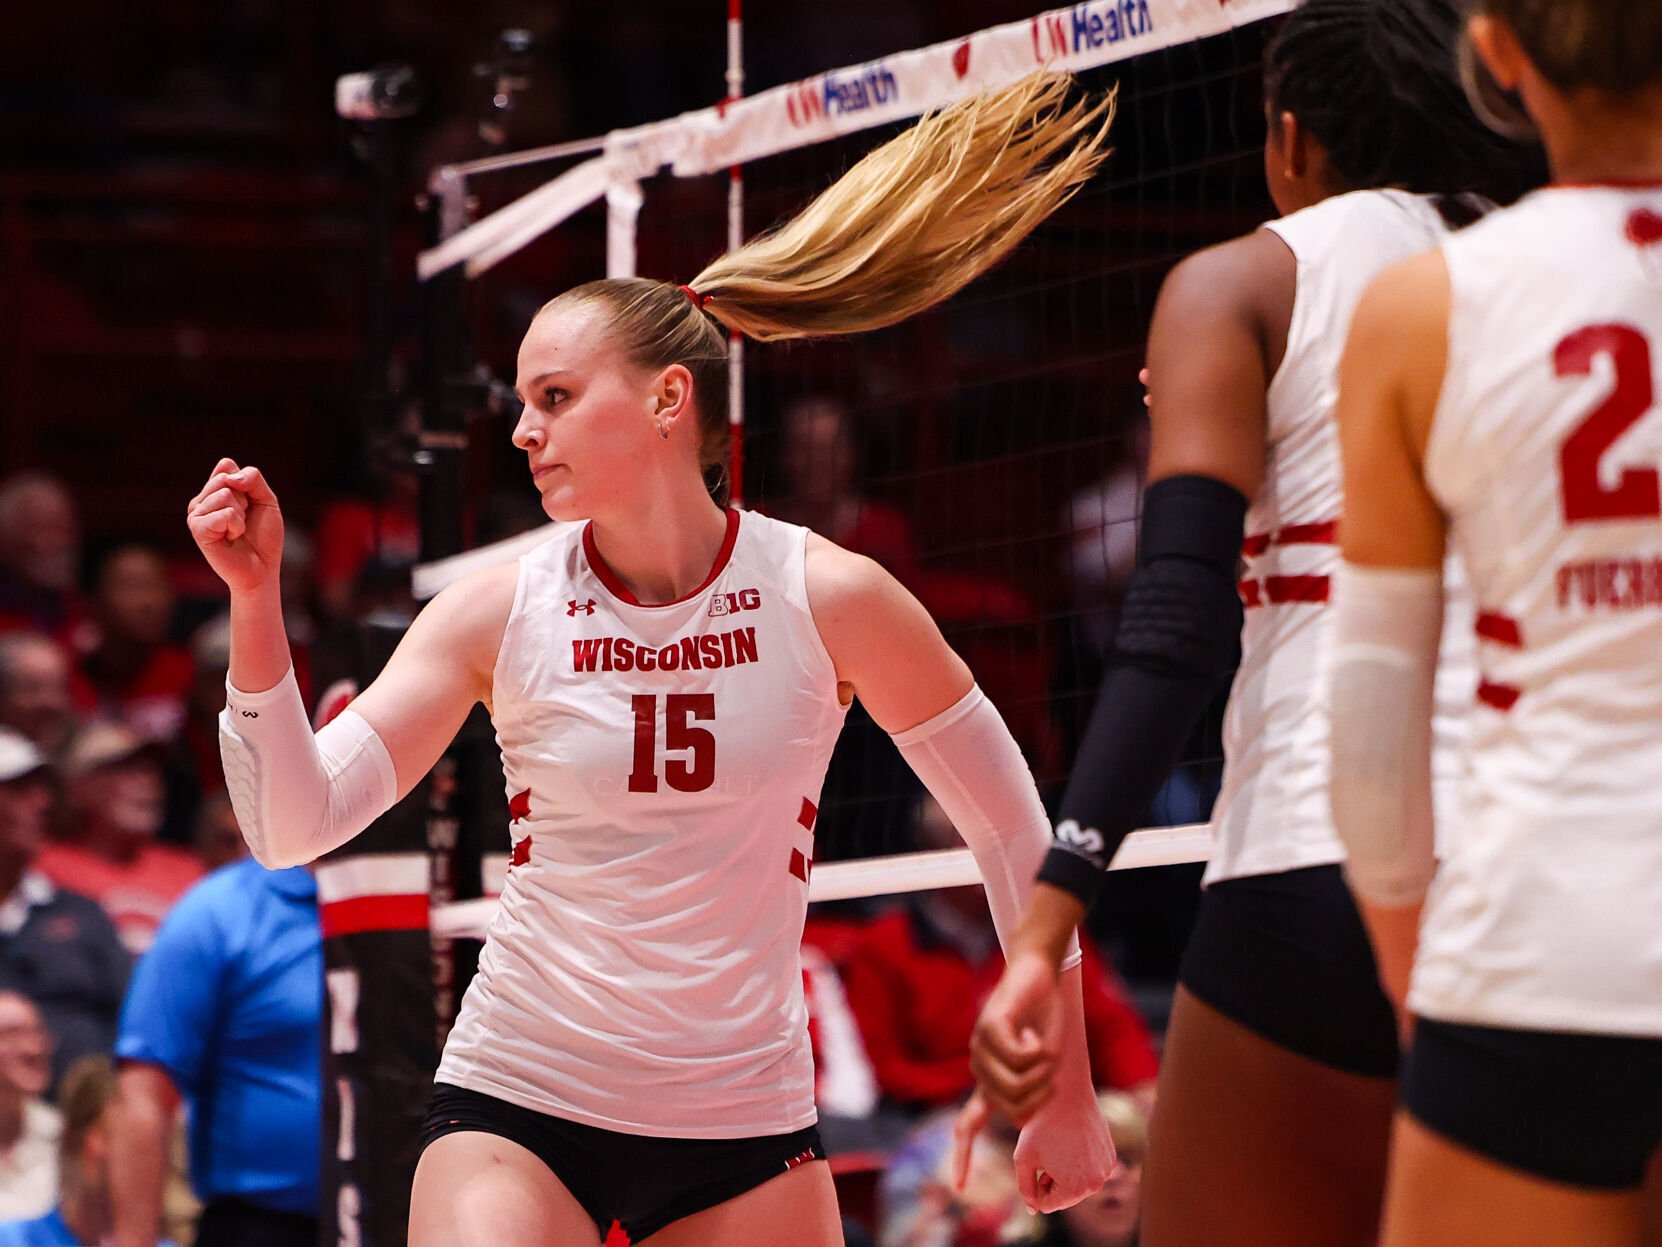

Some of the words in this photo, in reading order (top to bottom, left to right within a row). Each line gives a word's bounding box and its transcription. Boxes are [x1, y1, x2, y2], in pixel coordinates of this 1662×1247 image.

[1551, 321, 1661, 525] 2
[572, 627, 759, 673] WISCONSIN
[628, 693, 716, 793] 15
